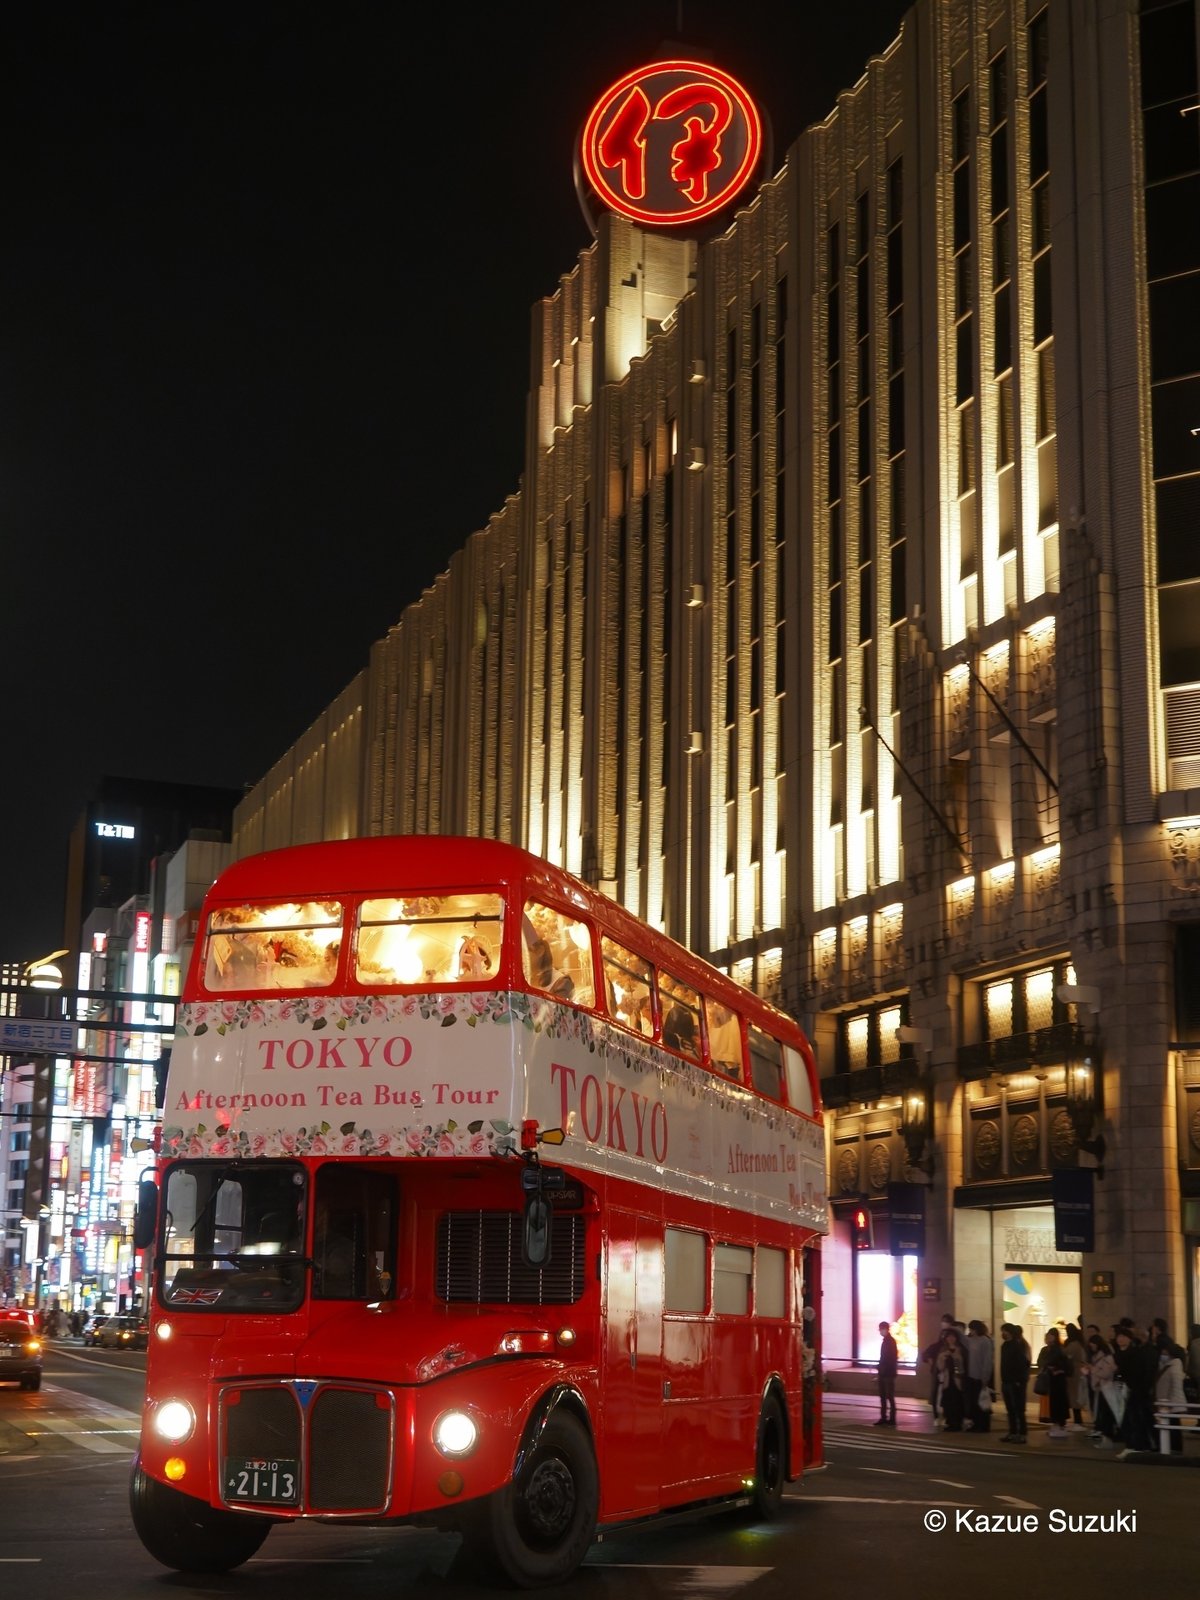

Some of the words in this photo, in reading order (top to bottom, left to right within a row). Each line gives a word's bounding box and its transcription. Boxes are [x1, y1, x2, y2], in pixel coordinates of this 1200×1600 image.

[598, 84, 734, 204] 伊
[4, 1023, 73, 1040] 新宿三丁目
[259, 1036, 413, 1070] TOKYO
[175, 1089, 306, 1110] Afternoon
[316, 1085, 363, 1107] Tea
[374, 1084, 422, 1106] Bus
[432, 1083, 500, 1105] Tour
[550, 1063, 669, 1164] TOKYO
[727, 1143, 778, 1173] Afternoon
[779, 1144, 797, 1173] Tea
[236, 1471, 294, 1498] 21-13
